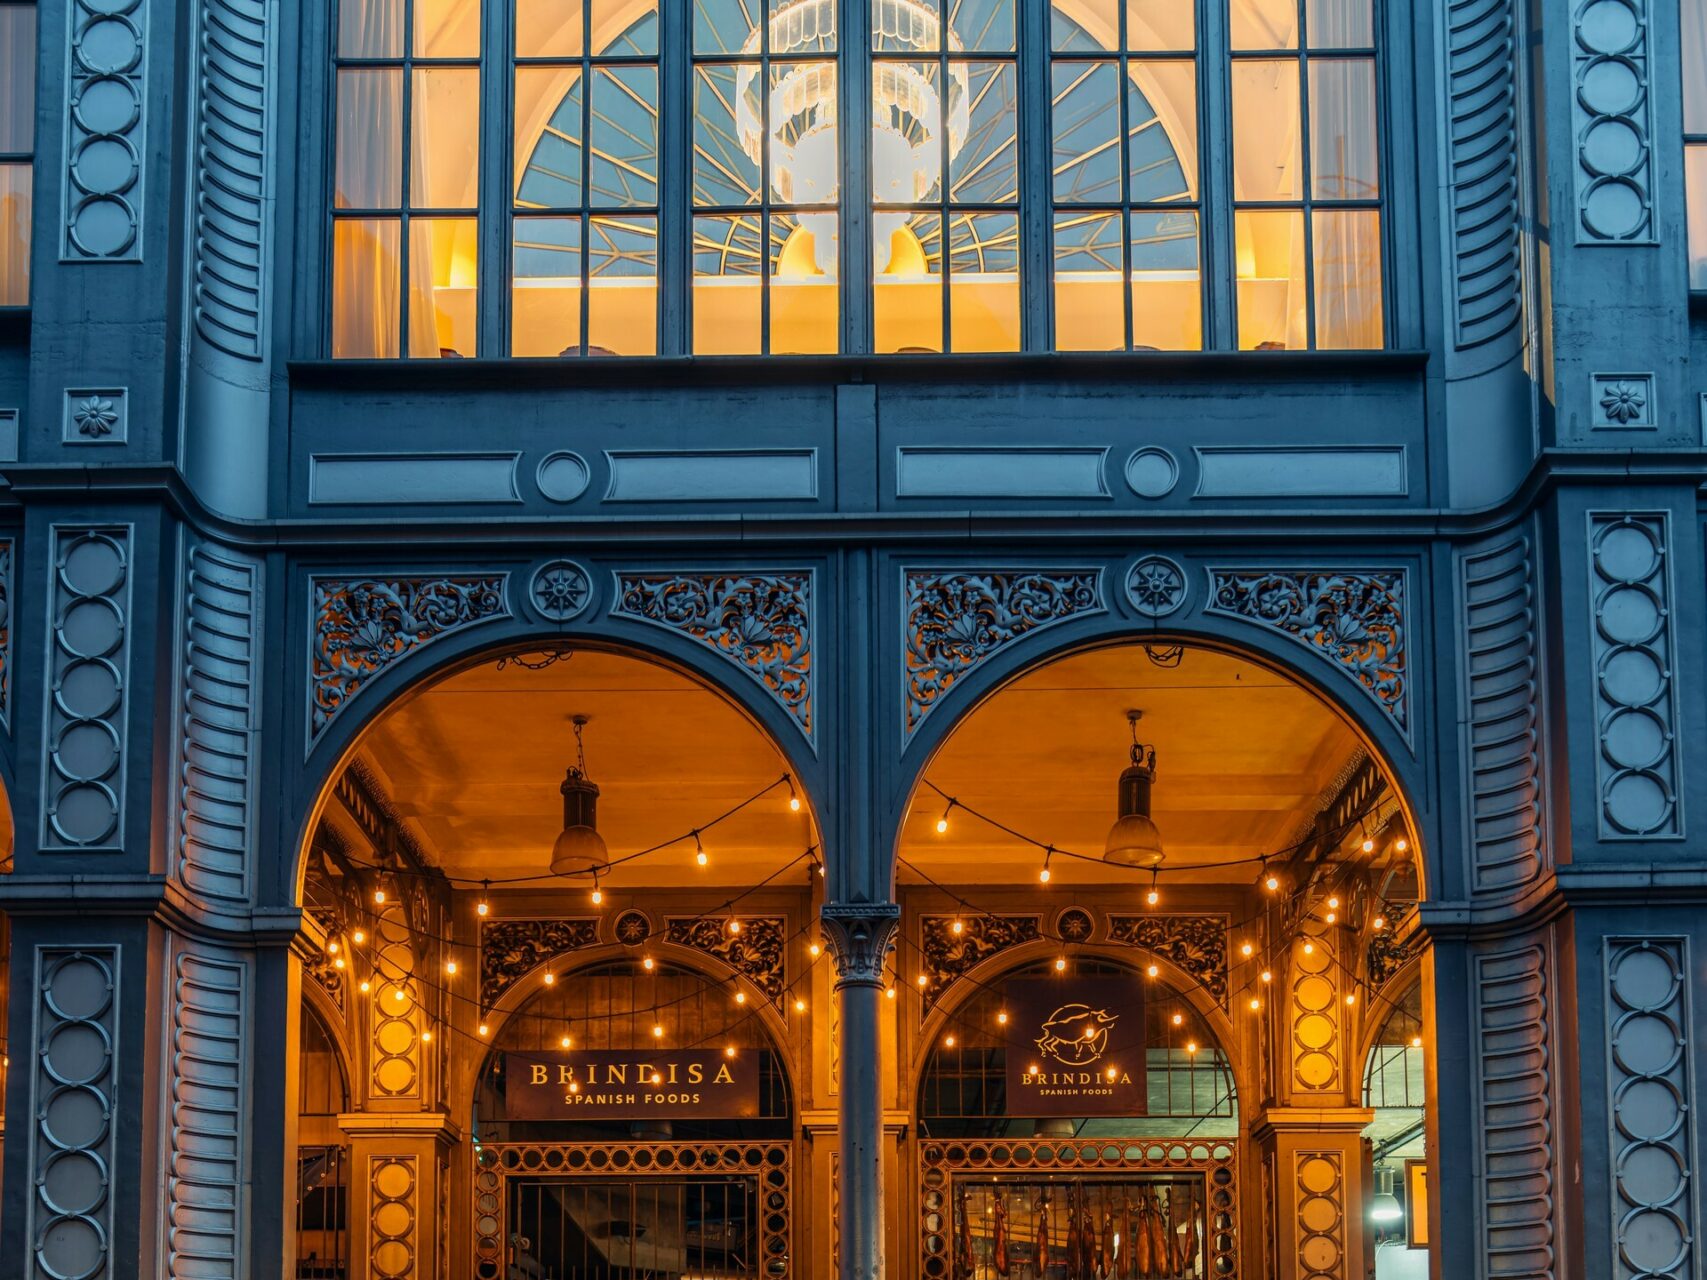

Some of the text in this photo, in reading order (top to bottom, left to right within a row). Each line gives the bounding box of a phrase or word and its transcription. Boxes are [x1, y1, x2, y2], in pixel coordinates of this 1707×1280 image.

[530, 1063, 735, 1085] BRINDISA
[565, 1093, 700, 1105] SPANISH FOODS
